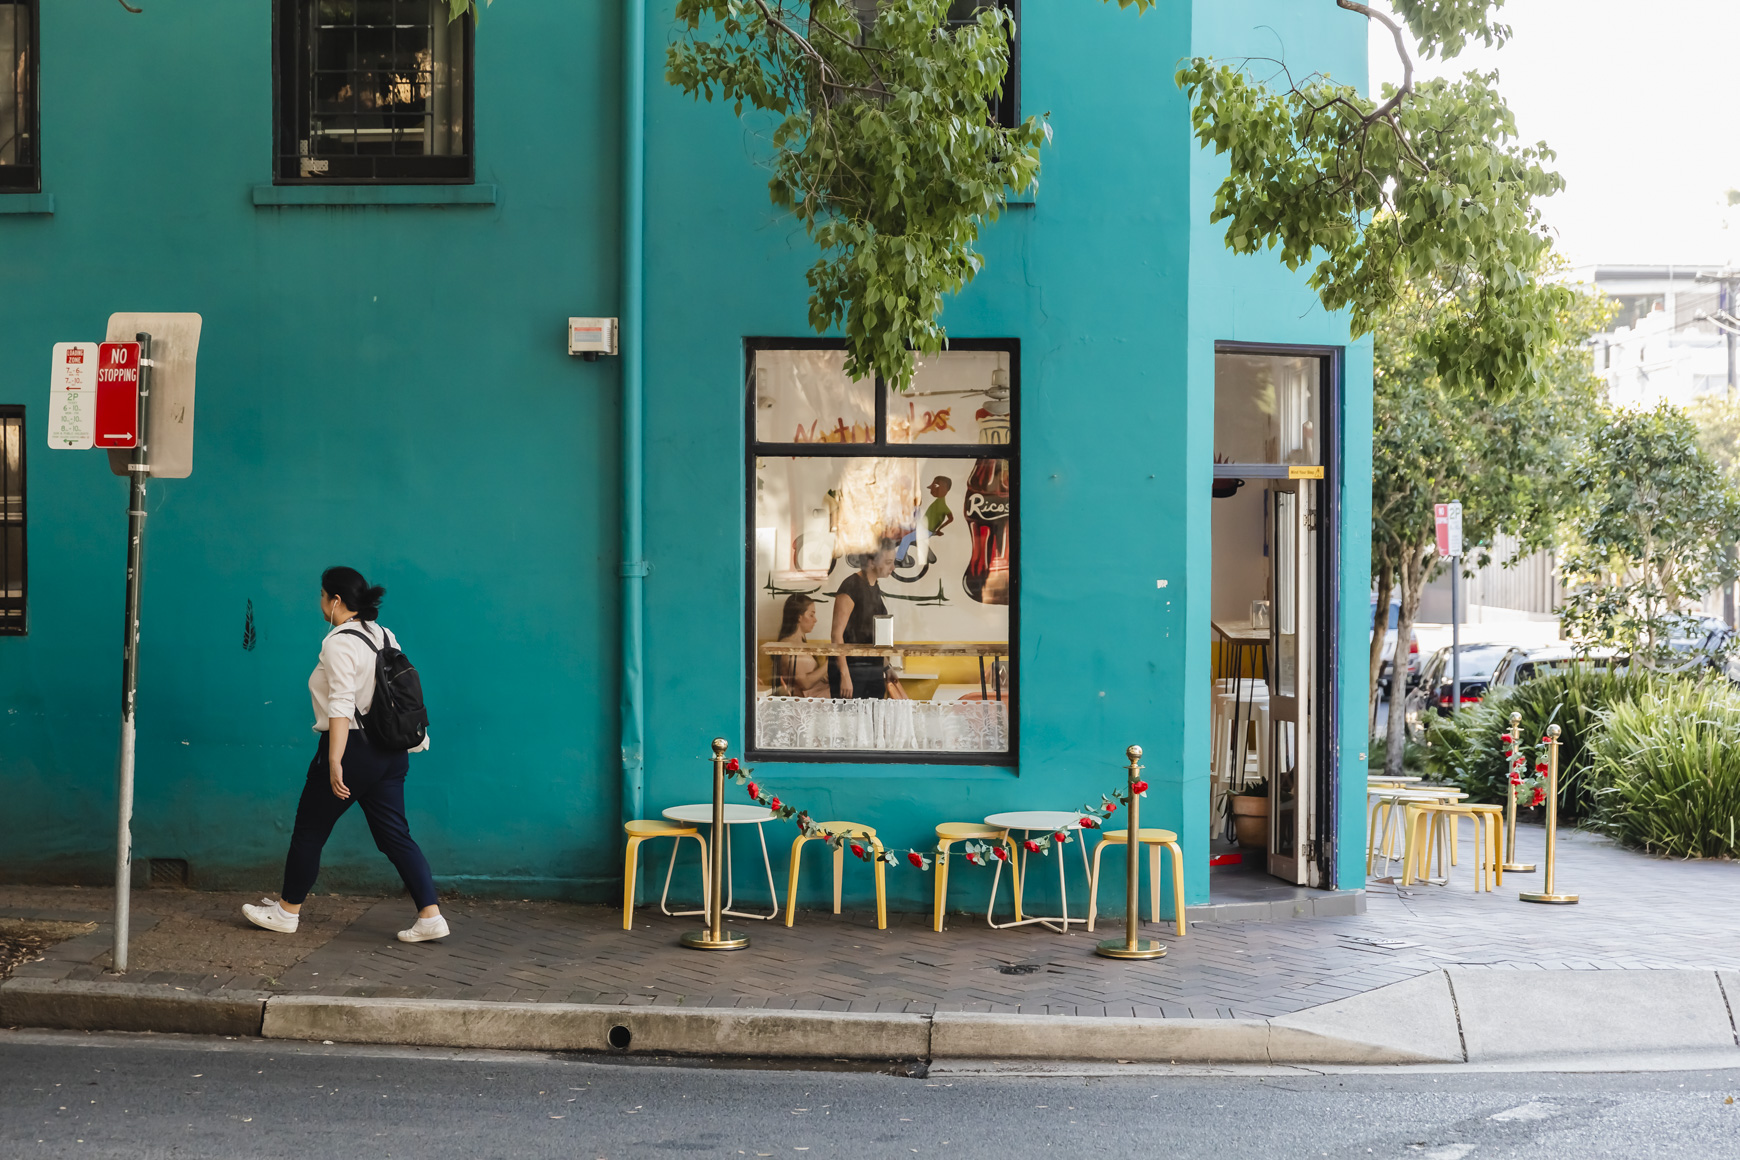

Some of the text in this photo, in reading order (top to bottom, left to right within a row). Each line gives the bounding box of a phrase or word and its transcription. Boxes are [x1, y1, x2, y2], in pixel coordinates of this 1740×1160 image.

[111, 348, 127, 364] NO
[99, 368, 137, 382] STOPPING
[67, 392, 79, 401] 2P
[1450, 507, 1460, 519] 2P
